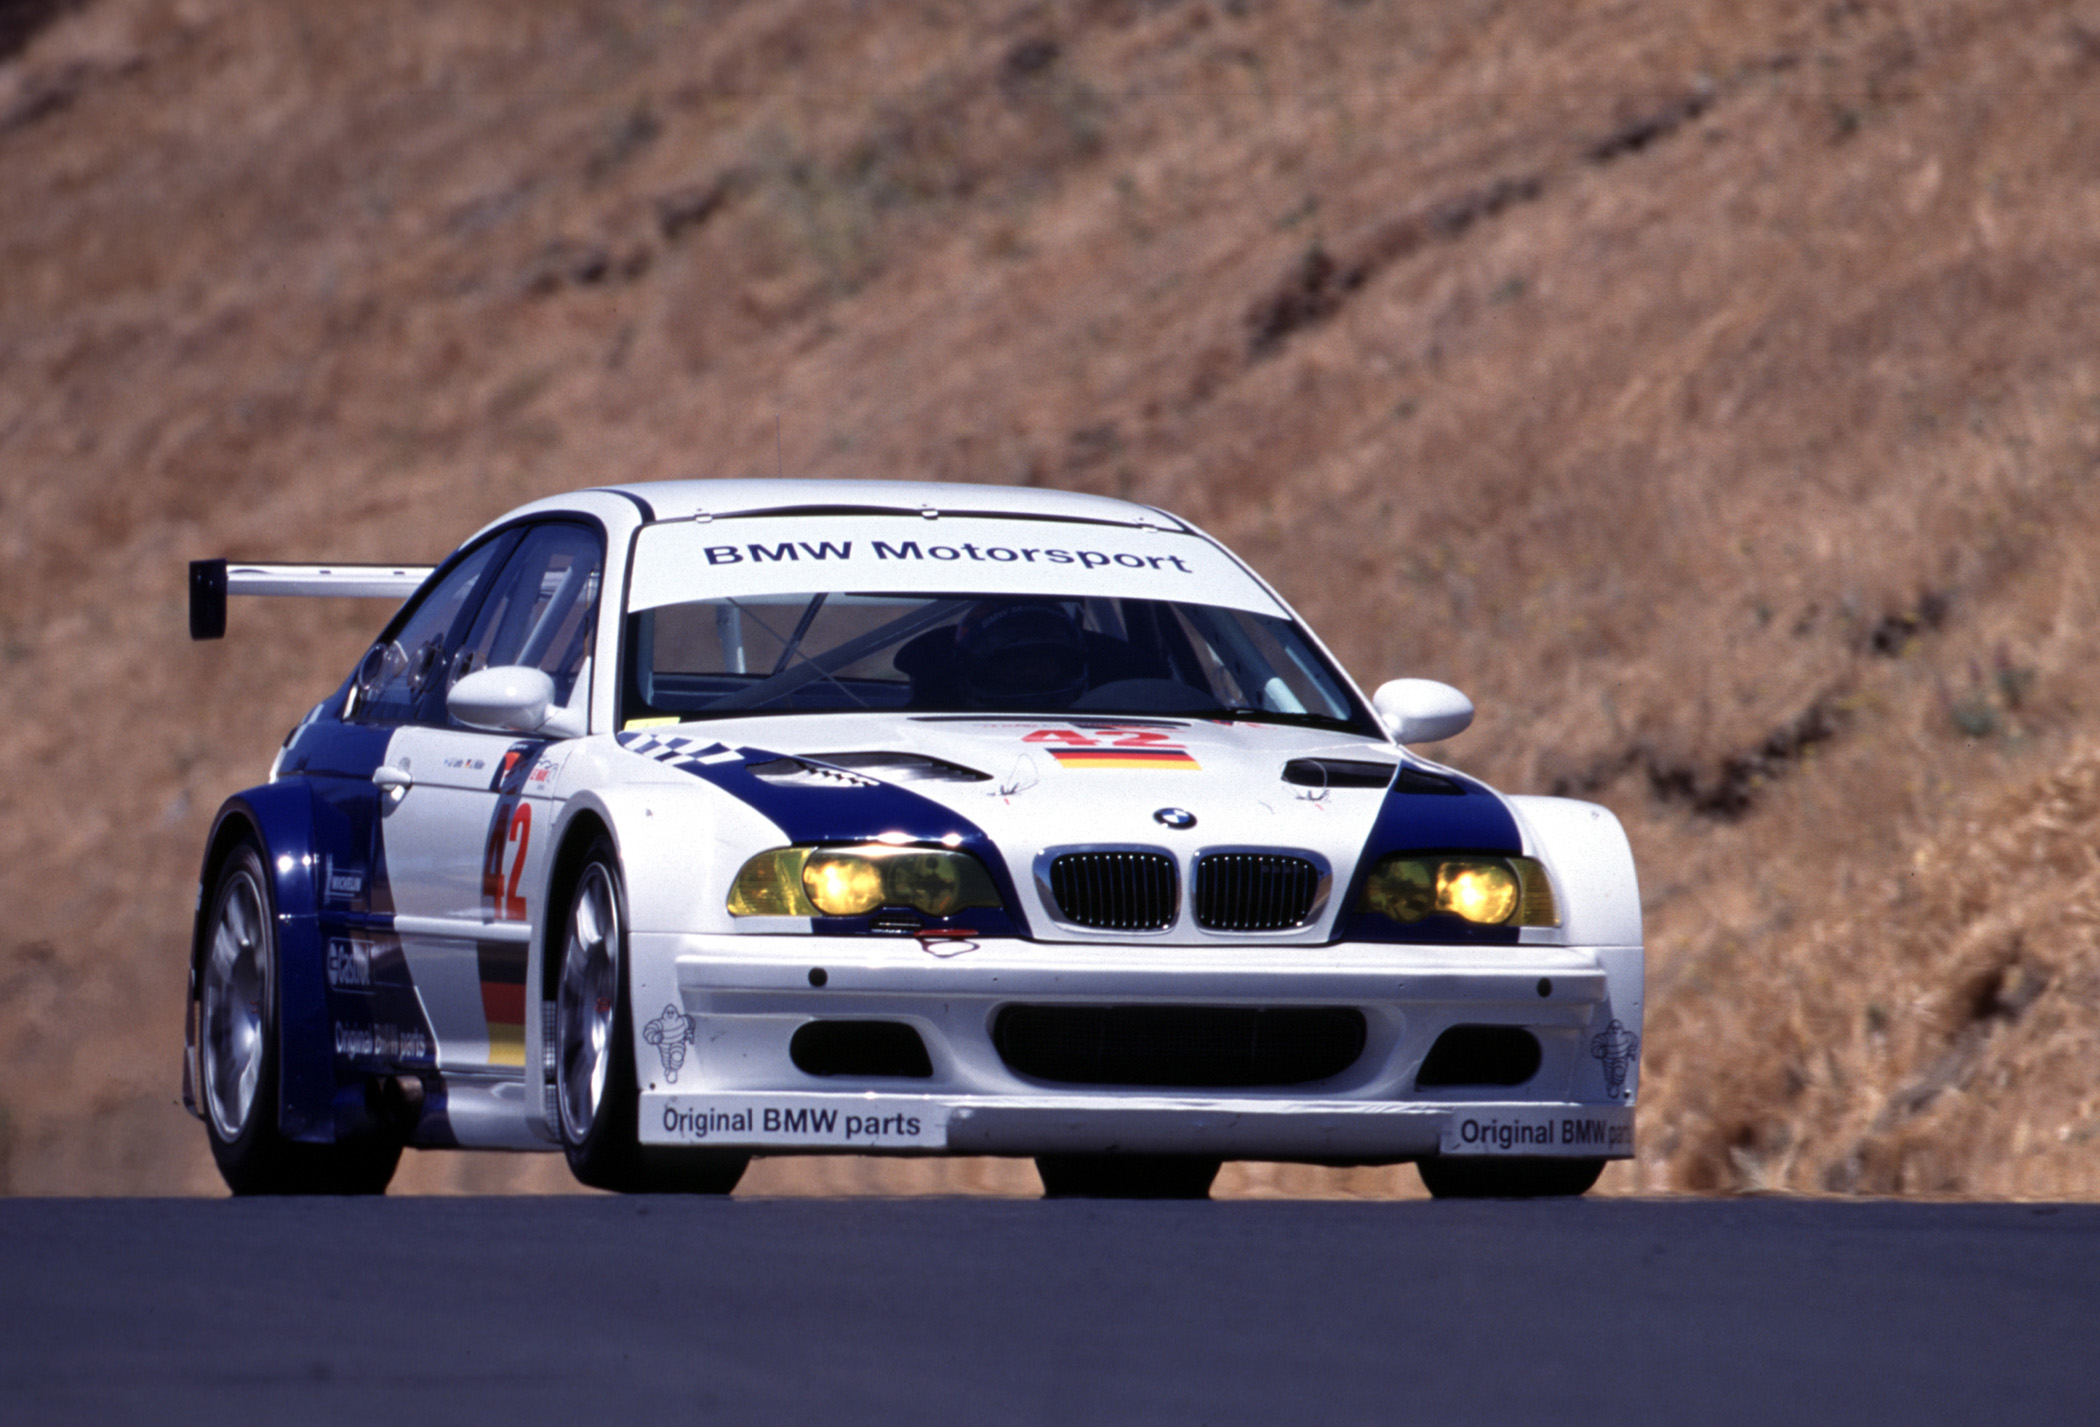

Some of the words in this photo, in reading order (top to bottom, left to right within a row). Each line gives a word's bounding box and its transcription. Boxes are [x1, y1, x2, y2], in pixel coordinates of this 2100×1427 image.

[703, 541, 853, 566] BMW
[871, 540, 1194, 574] Motorsport
[1022, 729, 1189, 749] 42
[482, 802, 532, 921] 42
[331, 875, 363, 893] MICHELIN
[335, 1020, 374, 1061] Original
[399, 1026, 425, 1063] parts
[663, 1106, 752, 1138] Original
[762, 1109, 837, 1134] BMW
[845, 1112, 921, 1140] parts
[1461, 1118, 1554, 1150] Original
[1562, 1119, 1608, 1145] BMW
